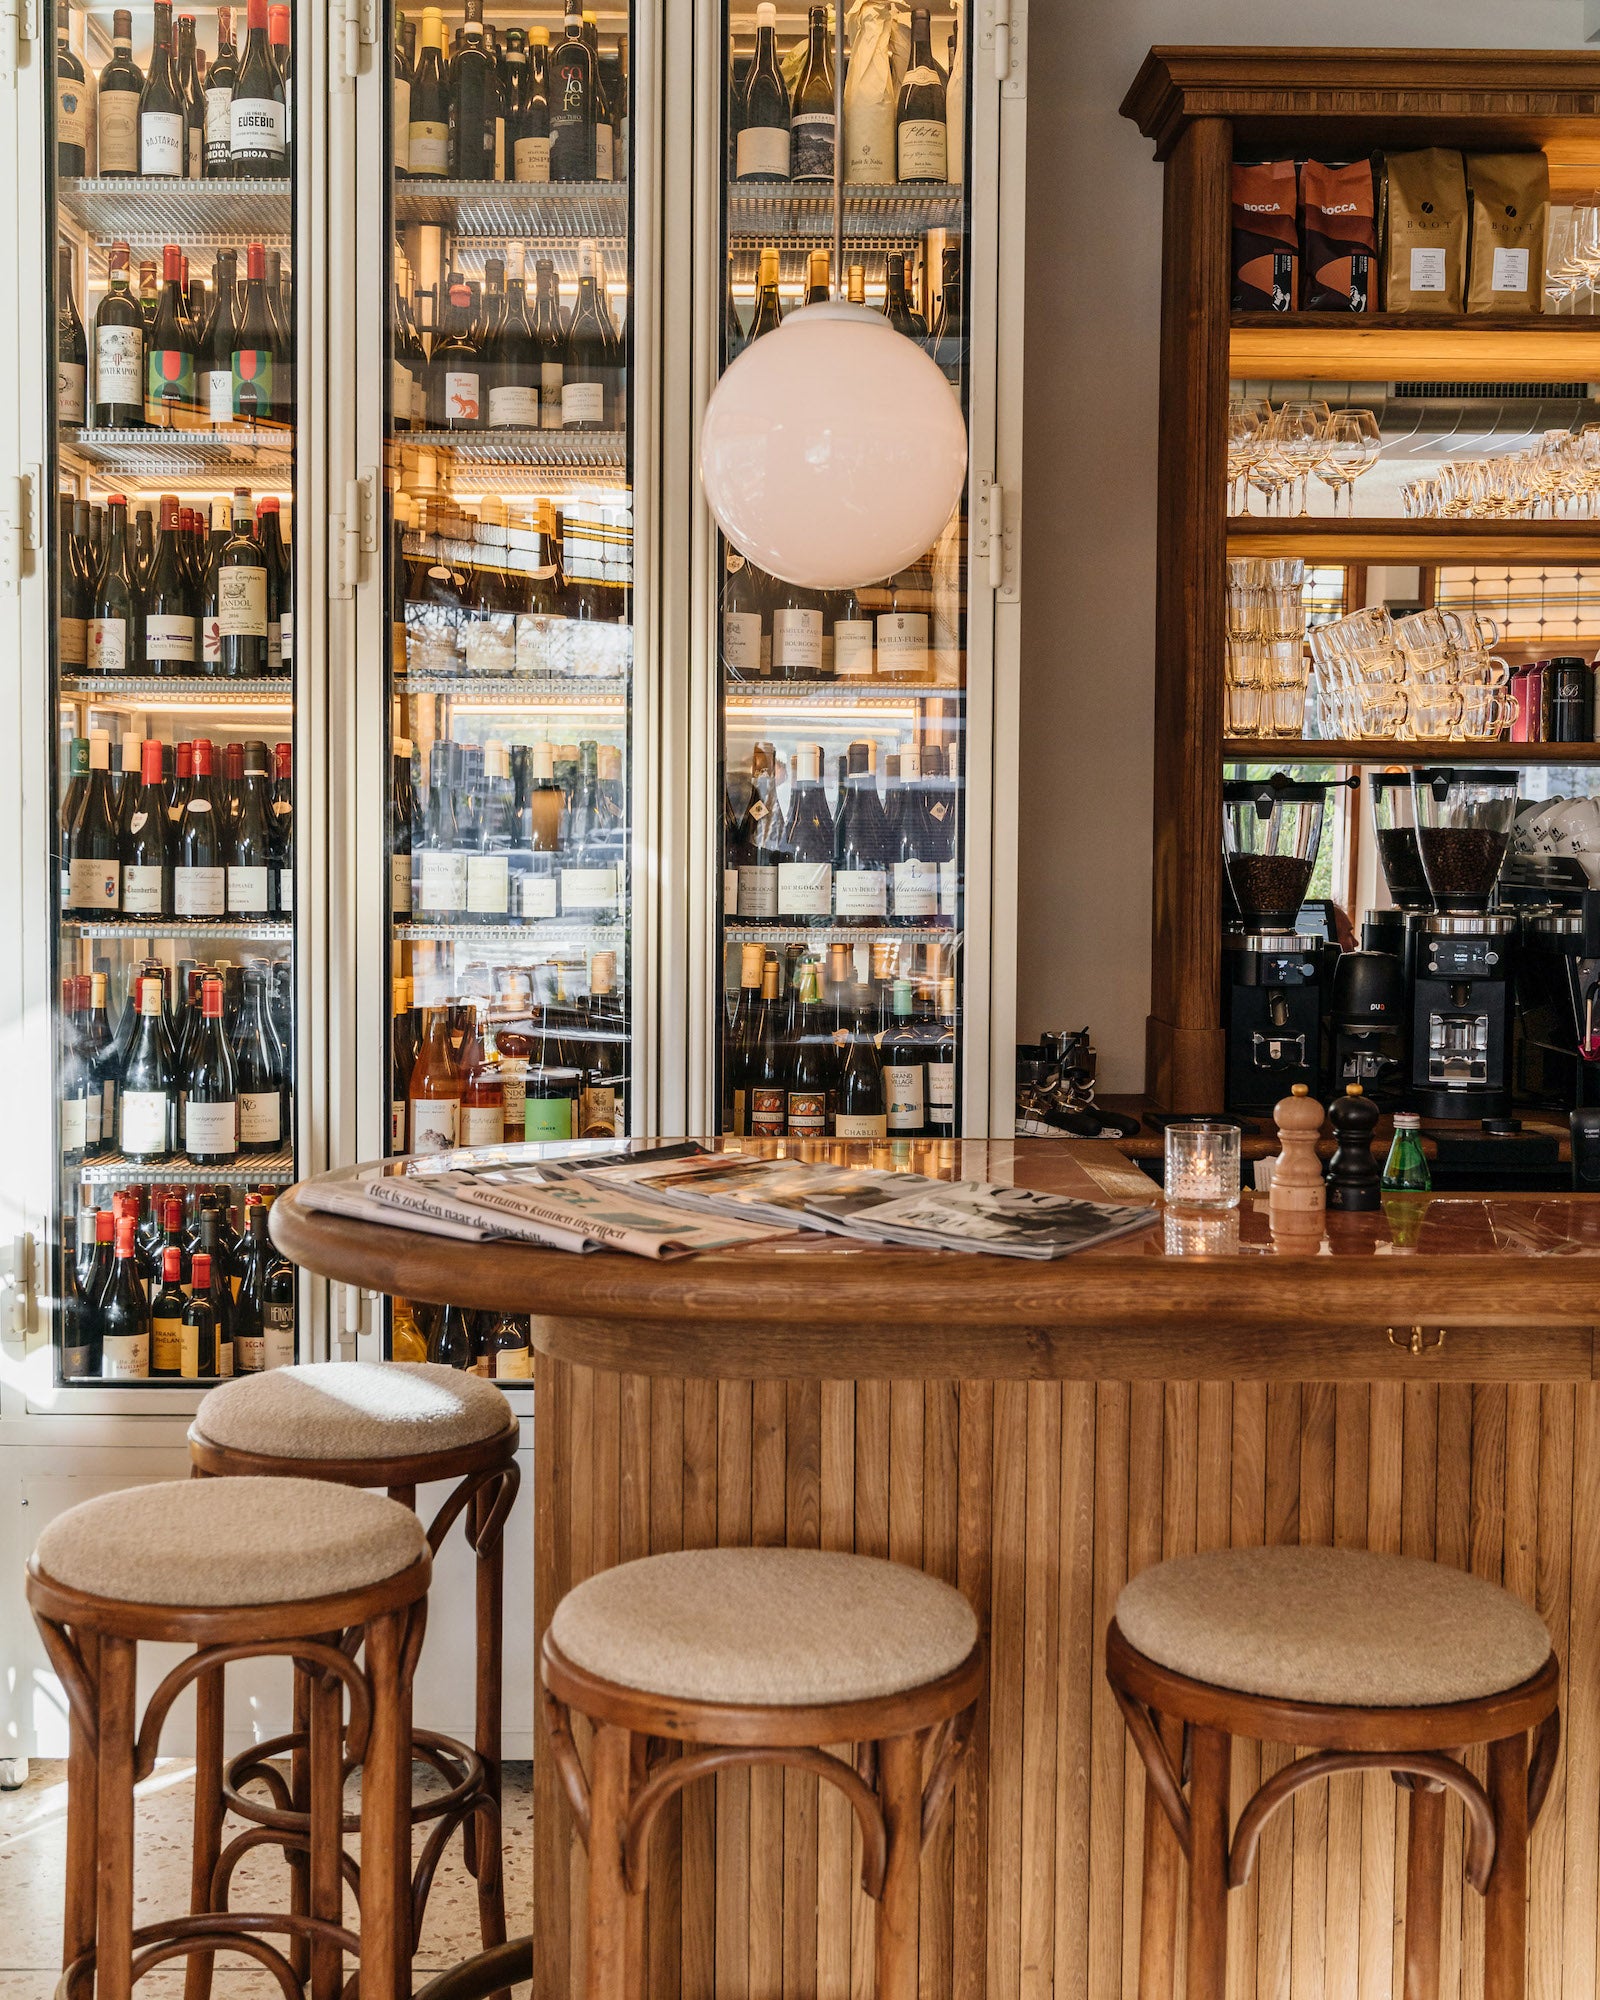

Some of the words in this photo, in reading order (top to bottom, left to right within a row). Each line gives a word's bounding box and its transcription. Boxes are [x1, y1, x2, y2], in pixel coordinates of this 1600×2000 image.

[561, 66, 583, 80] ca
[564, 74, 583, 93] la
[562, 92, 580, 111] fe
[238, 116, 274, 128] EUSEBIO
[209, 142, 226, 150] VIÑA
[242, 150, 268, 158] RIOJA
[1243, 202, 1281, 212] BOCCA
[1321, 202, 1357, 215] BOCCA
[1407, 220, 1452, 229] BOOT
[1491, 222, 1535, 233] BOOT
[844, 1128, 878, 1136] CHABLIS
[369, 1184, 389, 1199] Het
[391, 1189, 402, 1204] is
[402, 1195, 442, 1217] zoeken
[444, 1209, 472, 1223] naar
[473, 1215, 488, 1229] de
[473, 1190, 528, 1213] overnames
[529, 1205, 574, 1225] kunnen
[574, 1216, 627, 1239] ingrijpen
